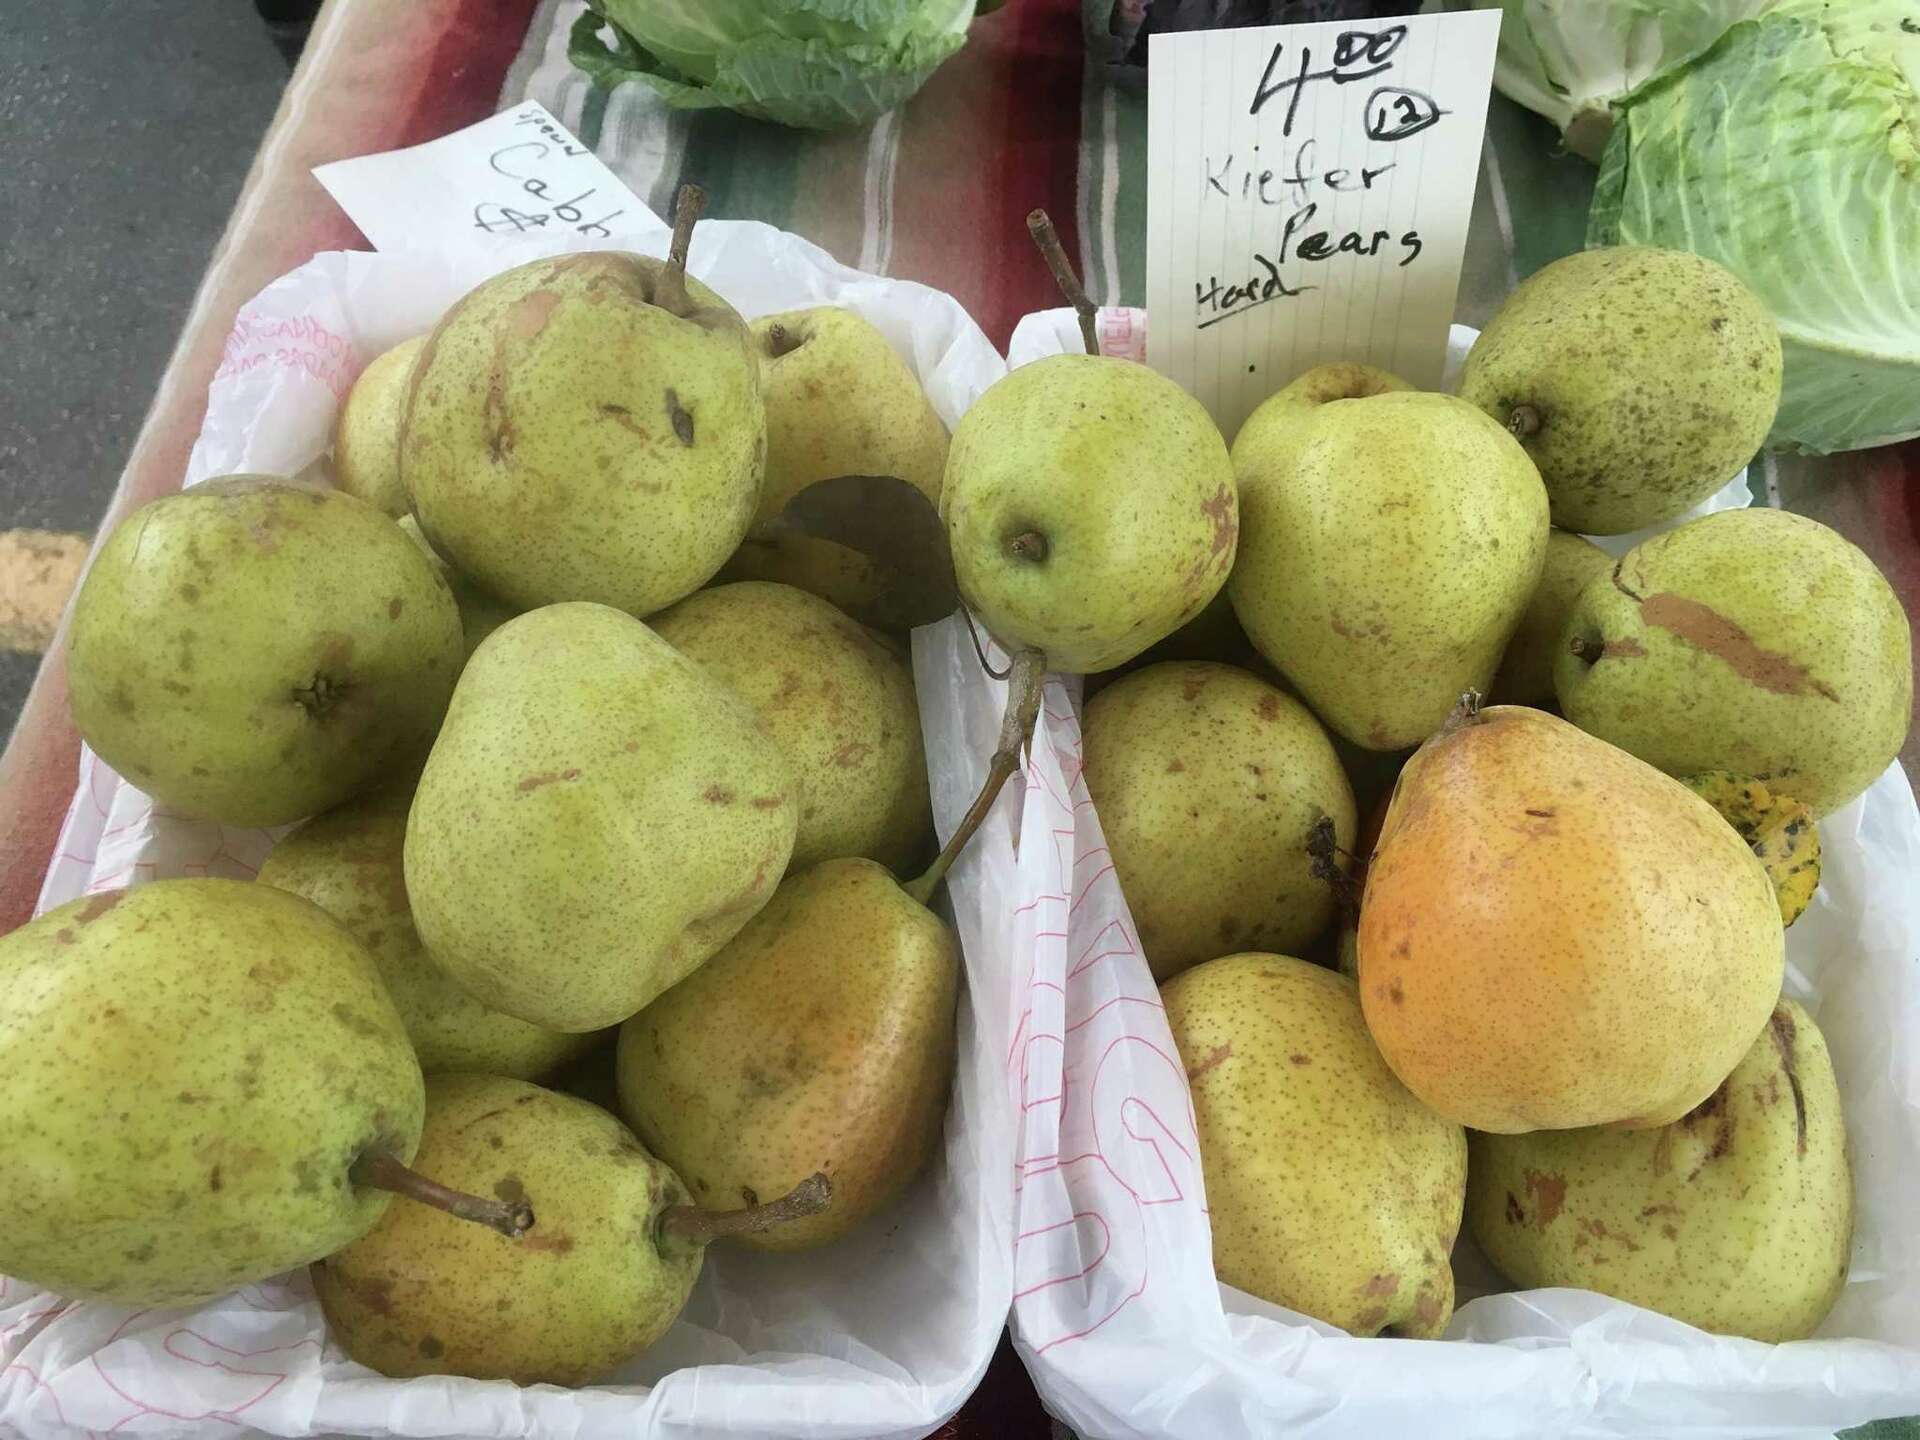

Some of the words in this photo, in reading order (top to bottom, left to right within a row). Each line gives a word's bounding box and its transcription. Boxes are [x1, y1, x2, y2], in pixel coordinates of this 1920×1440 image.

[1205, 138, 1397, 208] Kiefer
[1279, 202, 1423, 267] Pears
[1196, 253, 1313, 315] Hard
